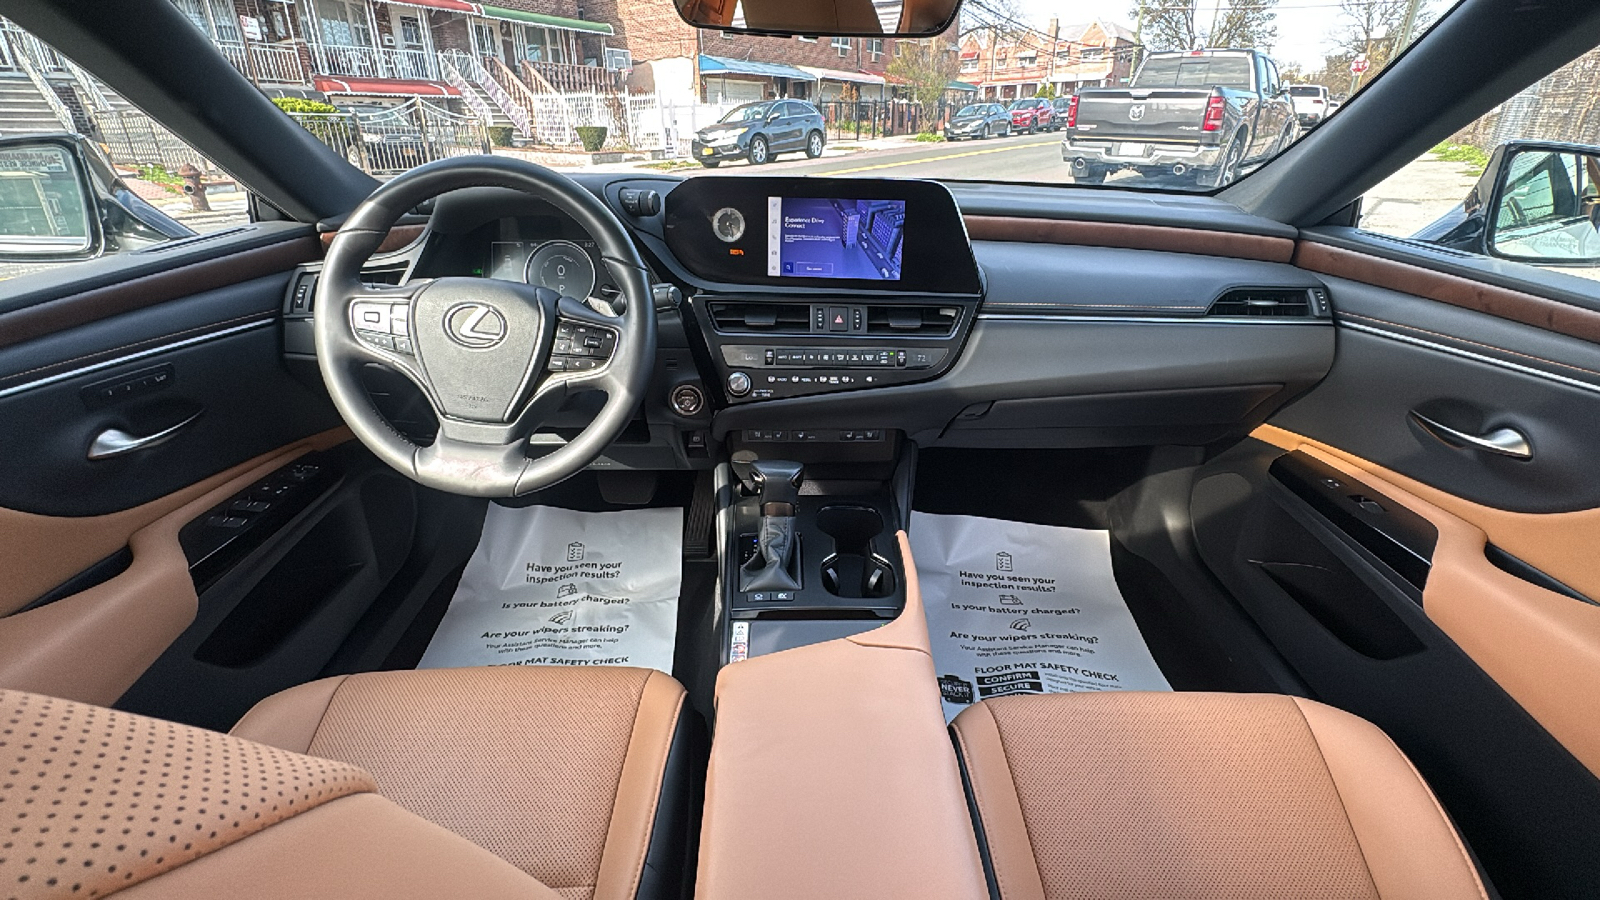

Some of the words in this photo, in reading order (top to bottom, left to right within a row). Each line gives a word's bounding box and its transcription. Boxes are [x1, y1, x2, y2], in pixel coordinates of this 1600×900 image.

[557, 265, 565, 276] 0
[559, 285, 565, 295] P
[526, 562, 552, 573] Have
[554, 565, 573, 574] you
[575, 562, 597, 570] seen
[599, 562, 622, 570] your
[526, 571, 578, 584] inspection
[580, 570, 620, 578] results?
[959, 571, 984, 579] Have
[986, 573, 1005, 582] you
[1032, 577, 1056, 585] your
[961, 580, 1015, 590] inspection
[1016, 584, 1056, 593] results?
[540, 599, 579, 607] battery
[580, 594, 631, 605] charged?
[962, 604, 987, 612] your
[988, 606, 1029, 615] battery
[503, 630, 530, 638] your
[532, 625, 569, 636] wipers
[571, 625, 630, 634] streaking?
[950, 631, 969, 639] Are
[971, 633, 997, 642] your
[999, 633, 1038, 641] wipers
[1039, 632, 1099, 644] streaking?
[524, 657, 549, 666] MAT
[551, 657, 591, 666] SAFETY
[592, 656, 629, 665] CHECK
[974, 663, 1012, 674] FLOOR
[1040, 662, 1079, 675] SAFETY
[1081, 669, 1120, 682] CHECK
[984, 672, 1032, 684] CONFIRM
[941, 682, 970, 694] NEVER
[991, 682, 1031, 694] SECURE
